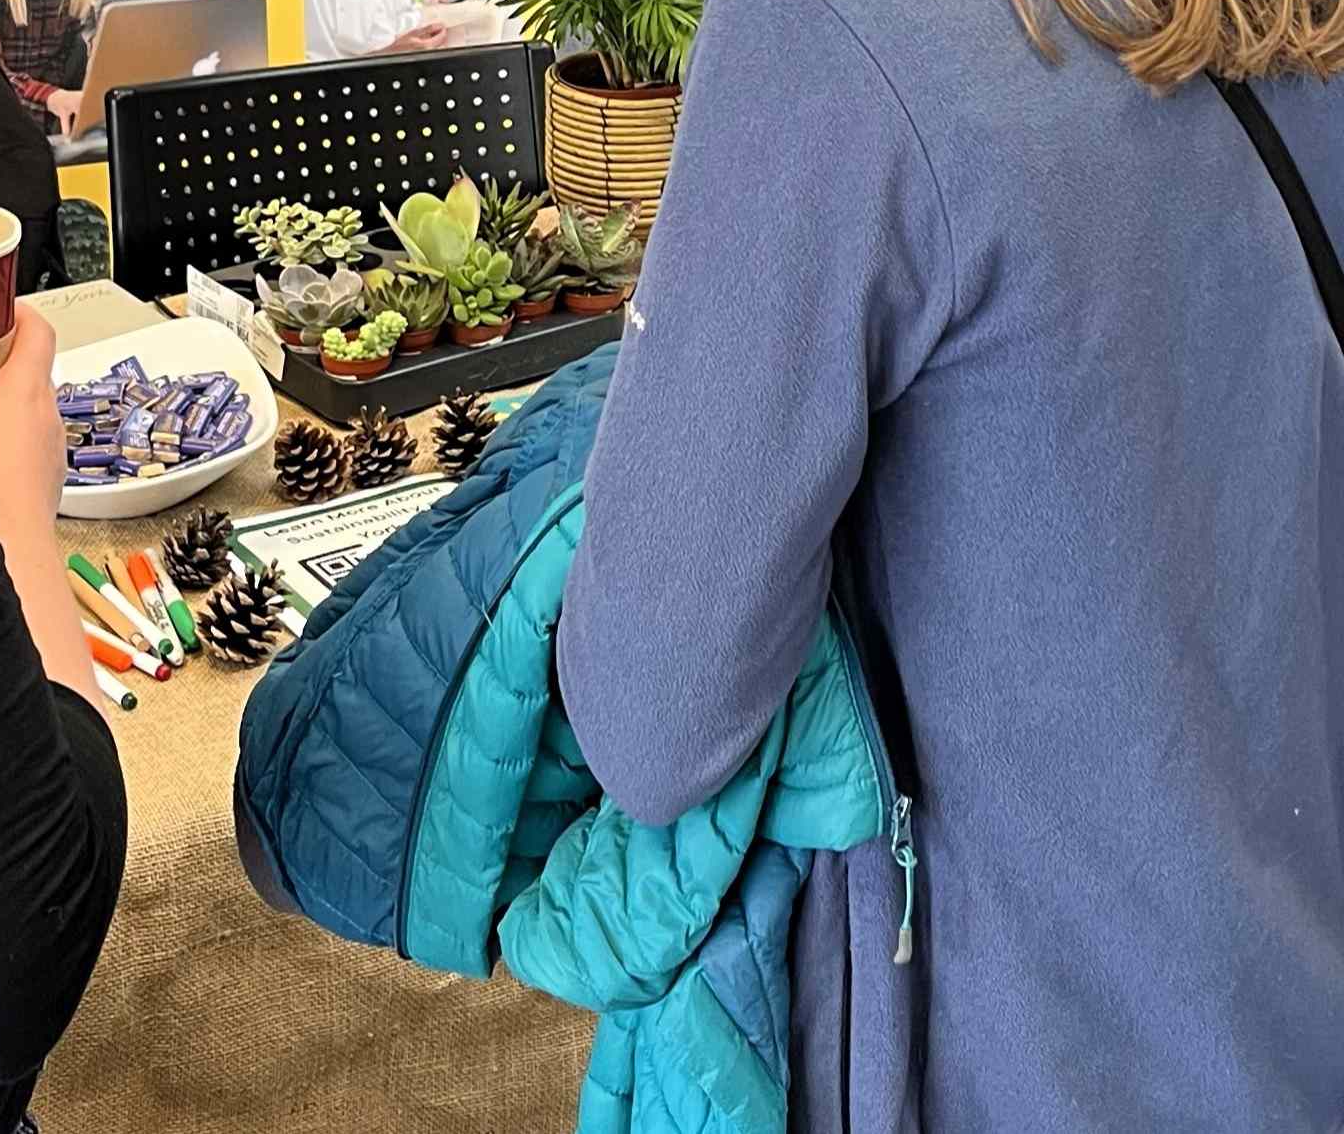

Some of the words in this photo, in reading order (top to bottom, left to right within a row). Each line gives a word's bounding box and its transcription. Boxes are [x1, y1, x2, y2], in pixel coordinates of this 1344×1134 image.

[264, 516, 323, 537] Learn
[327, 504, 378, 522] More
[385, 486, 442, 508] About
[286, 505, 420, 545] Sustainability
